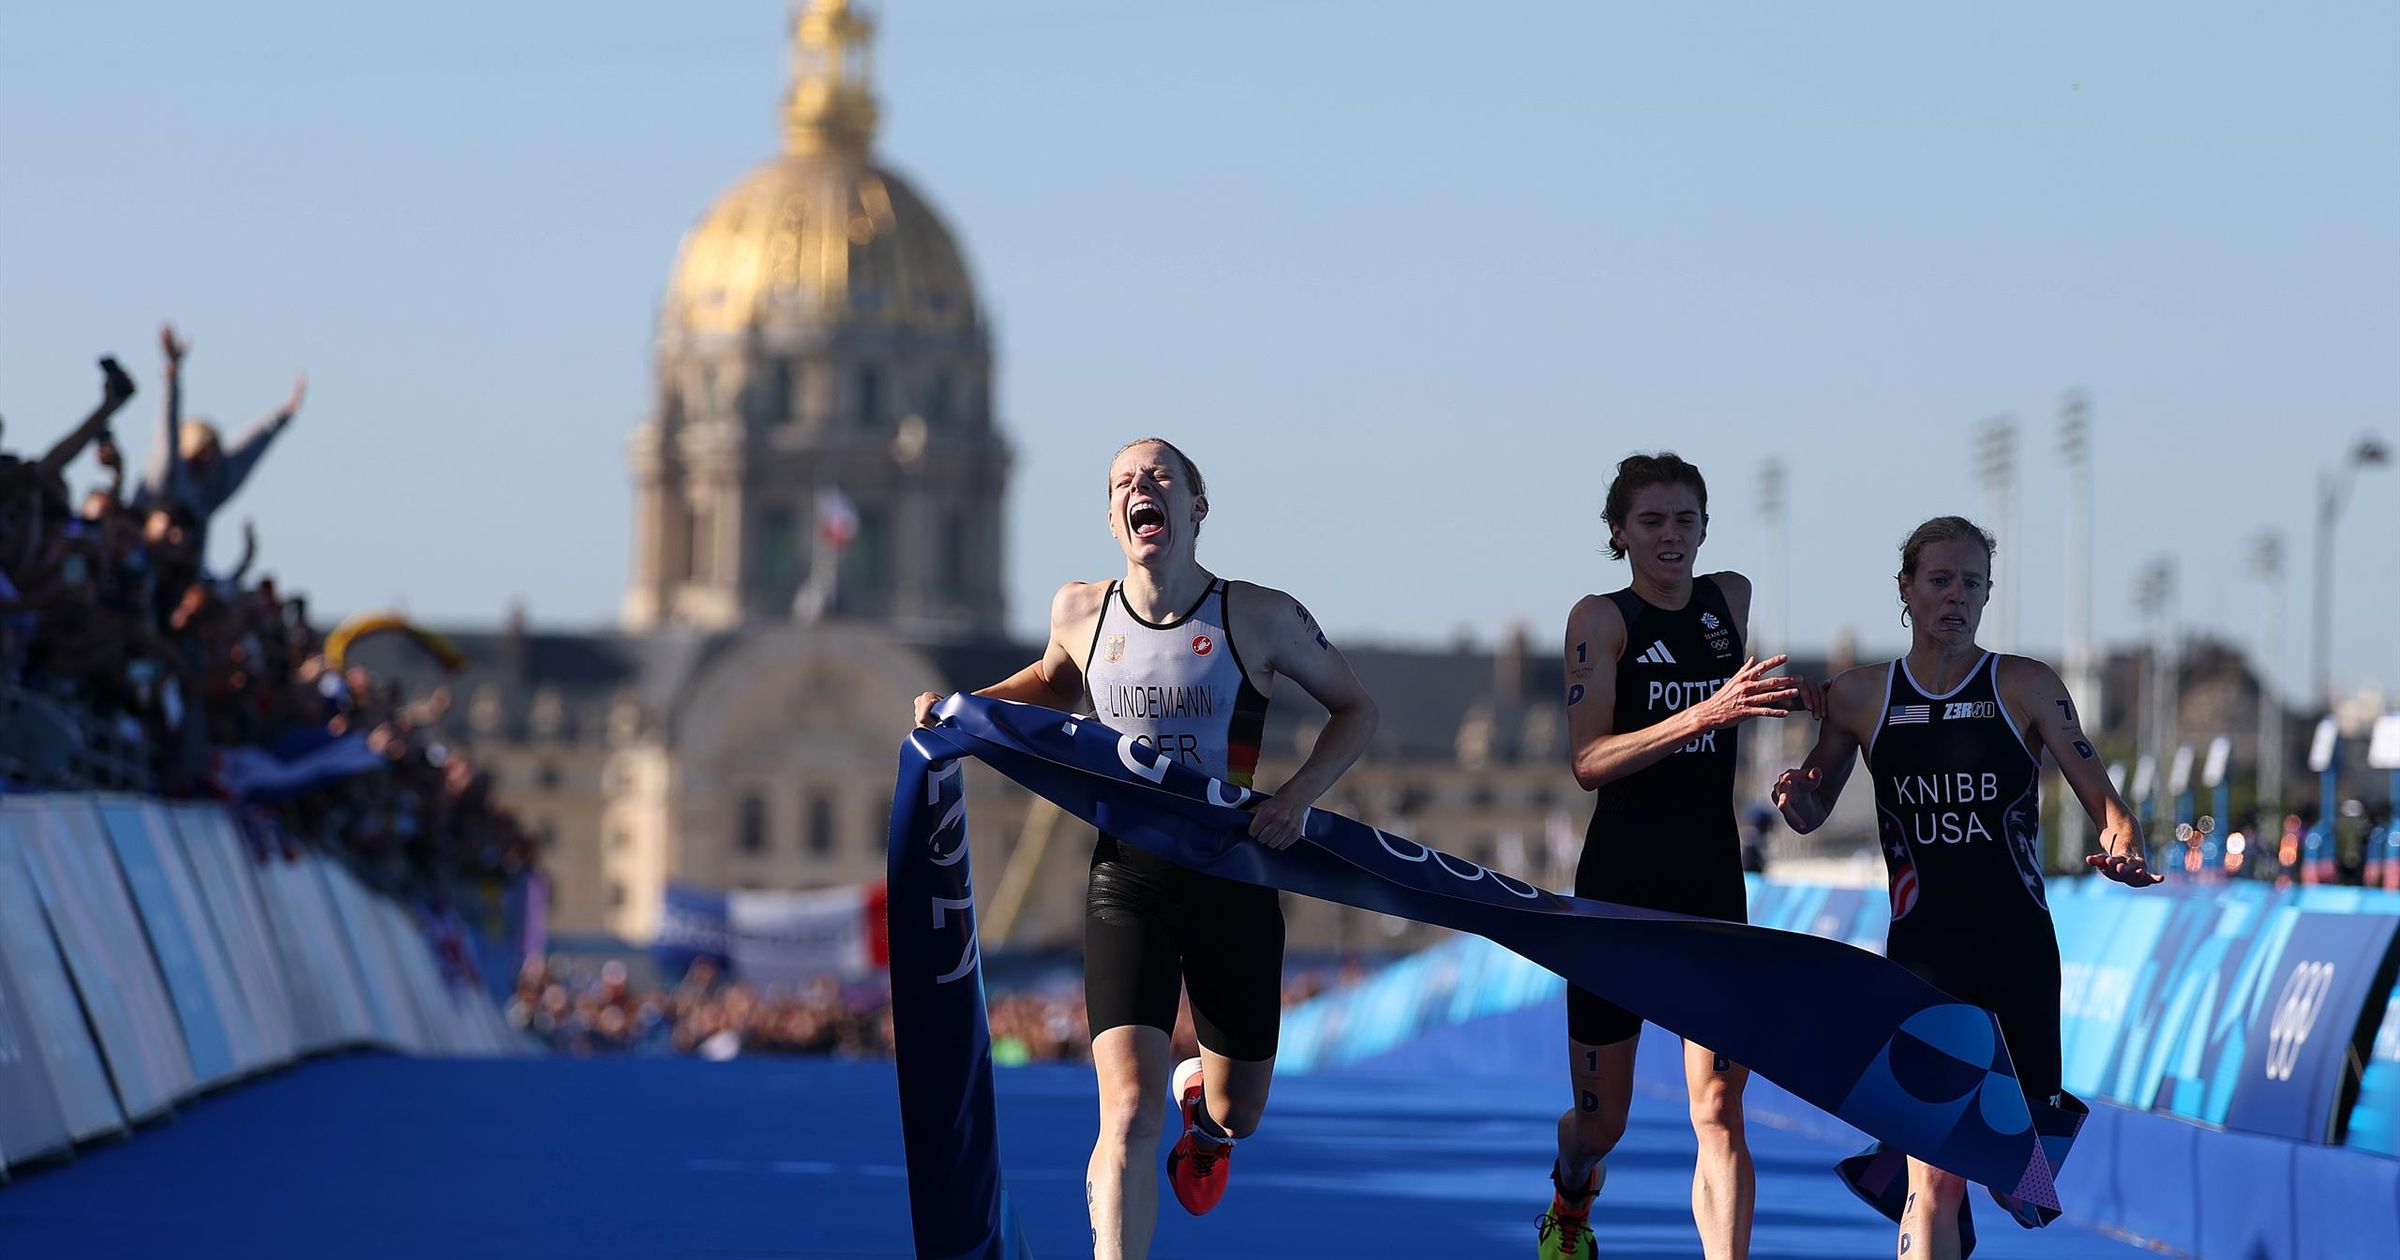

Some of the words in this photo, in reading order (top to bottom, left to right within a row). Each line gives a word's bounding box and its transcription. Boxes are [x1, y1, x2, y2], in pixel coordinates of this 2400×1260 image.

[1576, 641, 1587, 664] 1
[1109, 684, 1213, 719] LINDEMANN
[1567, 684, 1586, 707] D
[1648, 678, 1731, 711] POTTE
[1674, 729, 1717, 754] BR
[2071, 740, 2093, 760] D
[1893, 772, 1998, 805] KNIBB
[1915, 811, 1993, 845] USA
[1586, 1049, 1597, 1072] 1
[1582, 1089, 1600, 1113] D
[1900, 1232, 1912, 1256] D
